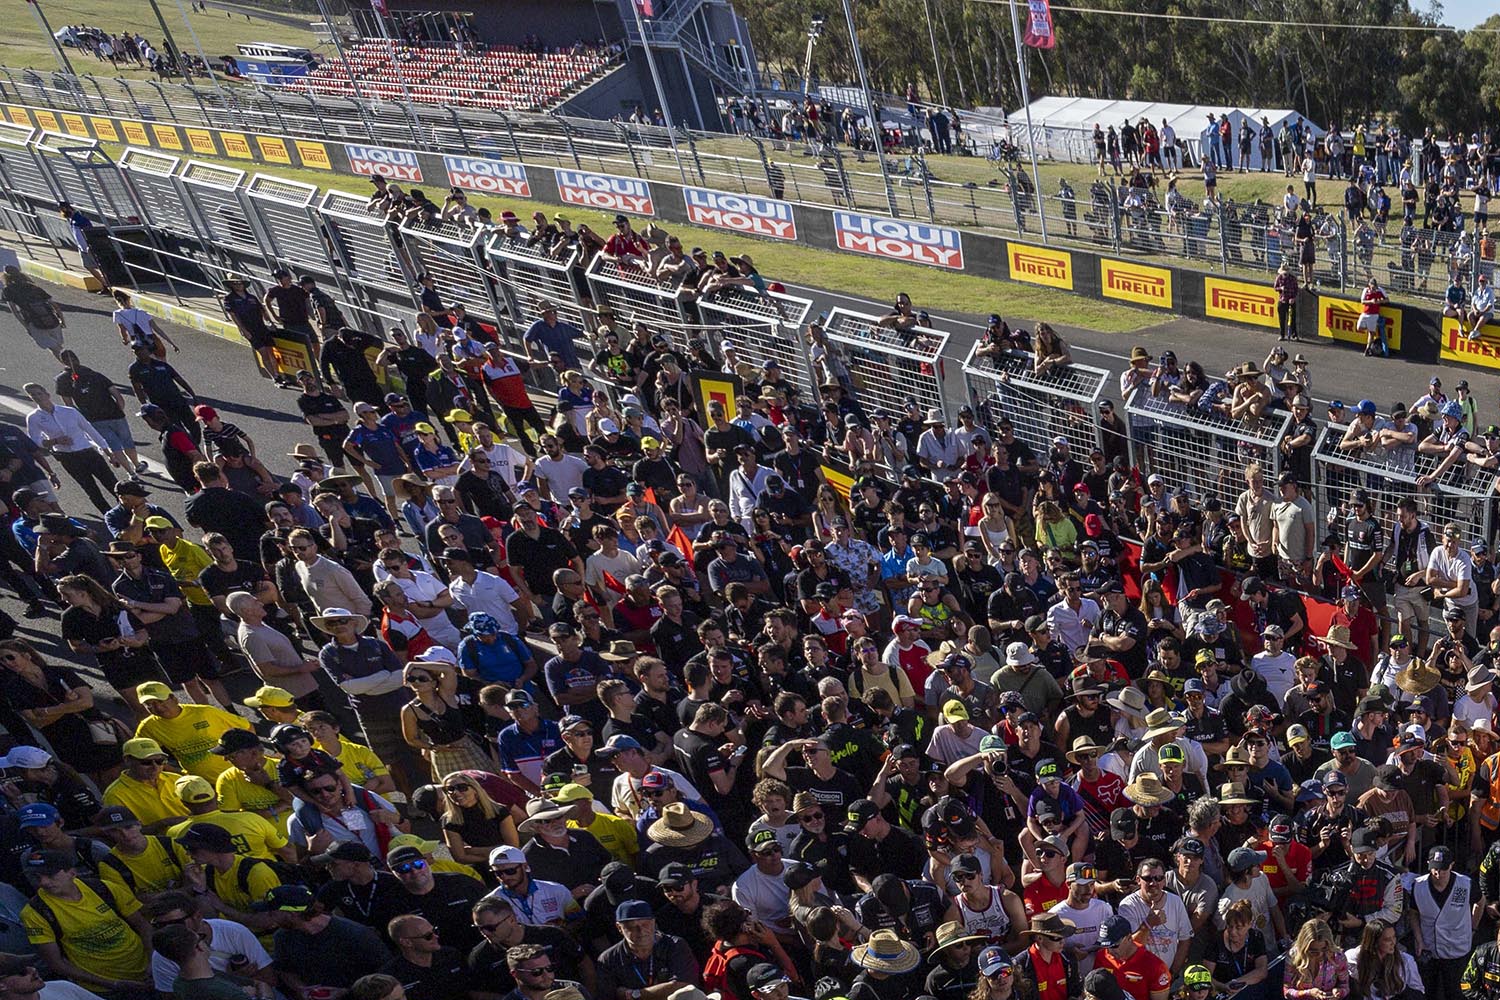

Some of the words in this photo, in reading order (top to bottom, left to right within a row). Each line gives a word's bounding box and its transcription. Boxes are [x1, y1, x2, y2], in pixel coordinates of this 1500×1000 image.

[225, 138, 249, 153] PIRELLI
[262, 142, 287, 158] PIRELLI
[300, 147, 327, 163] PIRELLI
[350, 146, 414, 167] LIQUI
[353, 160, 420, 181] MOLY
[450, 158, 521, 180] LIQUI
[452, 173, 526, 196] MOLY
[560, 171, 648, 197] LIQUI
[562, 187, 650, 214] MOLY
[688, 189, 788, 221] LIQUI
[692, 207, 795, 240] MOLY
[841, 215, 955, 249] LIQUI
[844, 233, 959, 268] MOLY
[1014, 252, 1066, 280] PIRELLI
[1107, 269, 1165, 298] PIRELLI
[1212, 287, 1275, 318] PIRELLI
[1039, 763, 1058, 777] 46
[753, 830, 774, 844] 46
